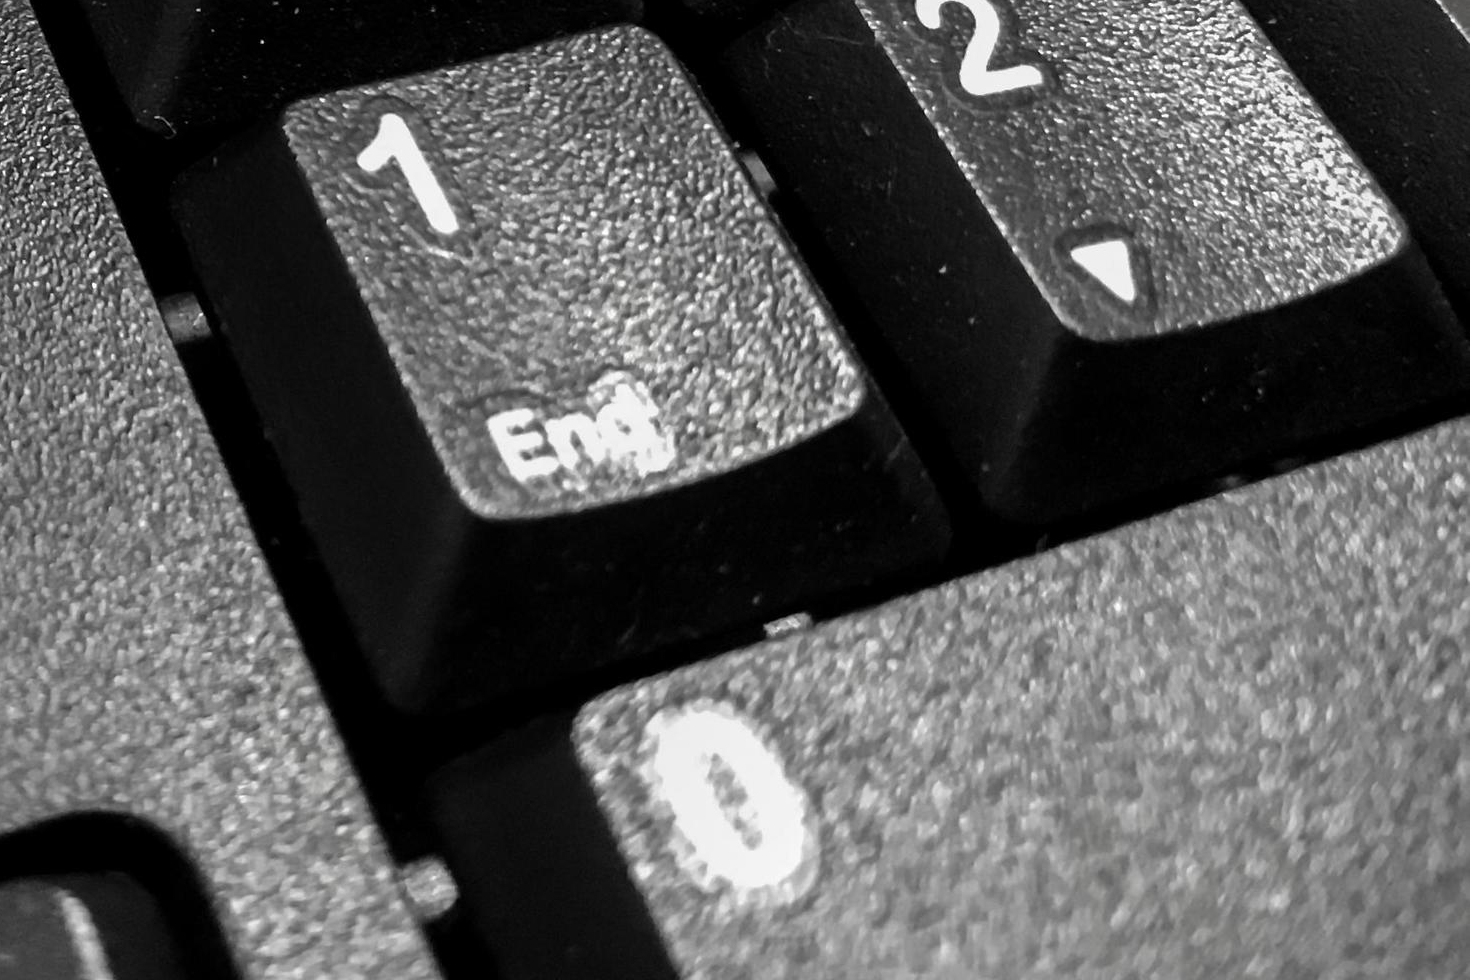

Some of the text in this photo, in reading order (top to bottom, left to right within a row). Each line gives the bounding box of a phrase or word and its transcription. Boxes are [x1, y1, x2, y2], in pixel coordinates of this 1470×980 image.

[356, 113, 458, 234] 1
[487, 372, 676, 482] End
[642, 701, 814, 896] 0
